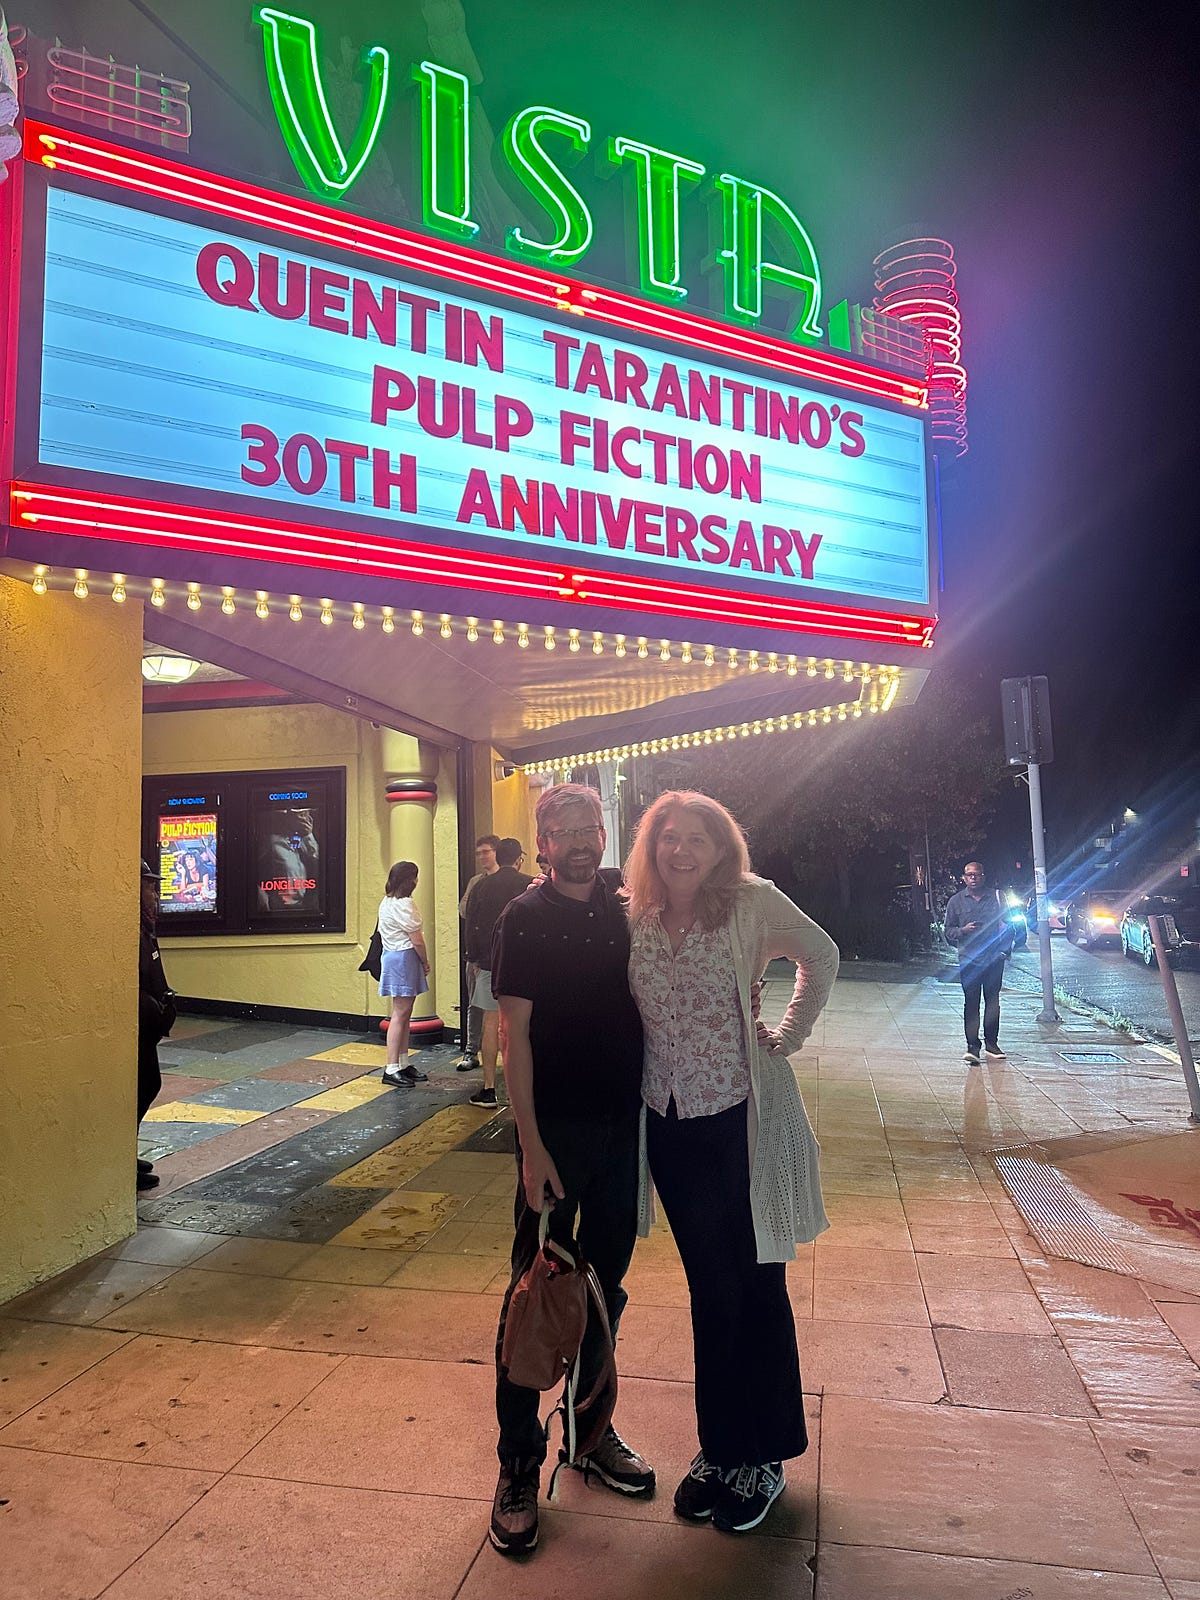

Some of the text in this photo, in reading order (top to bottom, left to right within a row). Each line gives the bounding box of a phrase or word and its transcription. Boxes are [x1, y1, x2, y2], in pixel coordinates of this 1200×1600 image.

[253, 4, 824, 342] VISTA
[196, 242, 866, 457] QUENTIN TARANTINO'S
[240, 423, 824, 580] 30TH ANNIVERSARY
[371, 364, 762, 504] PULP FICTION
[161, 821, 217, 837] PULP FICTION
[261, 879, 317, 891] LONGLEGS
